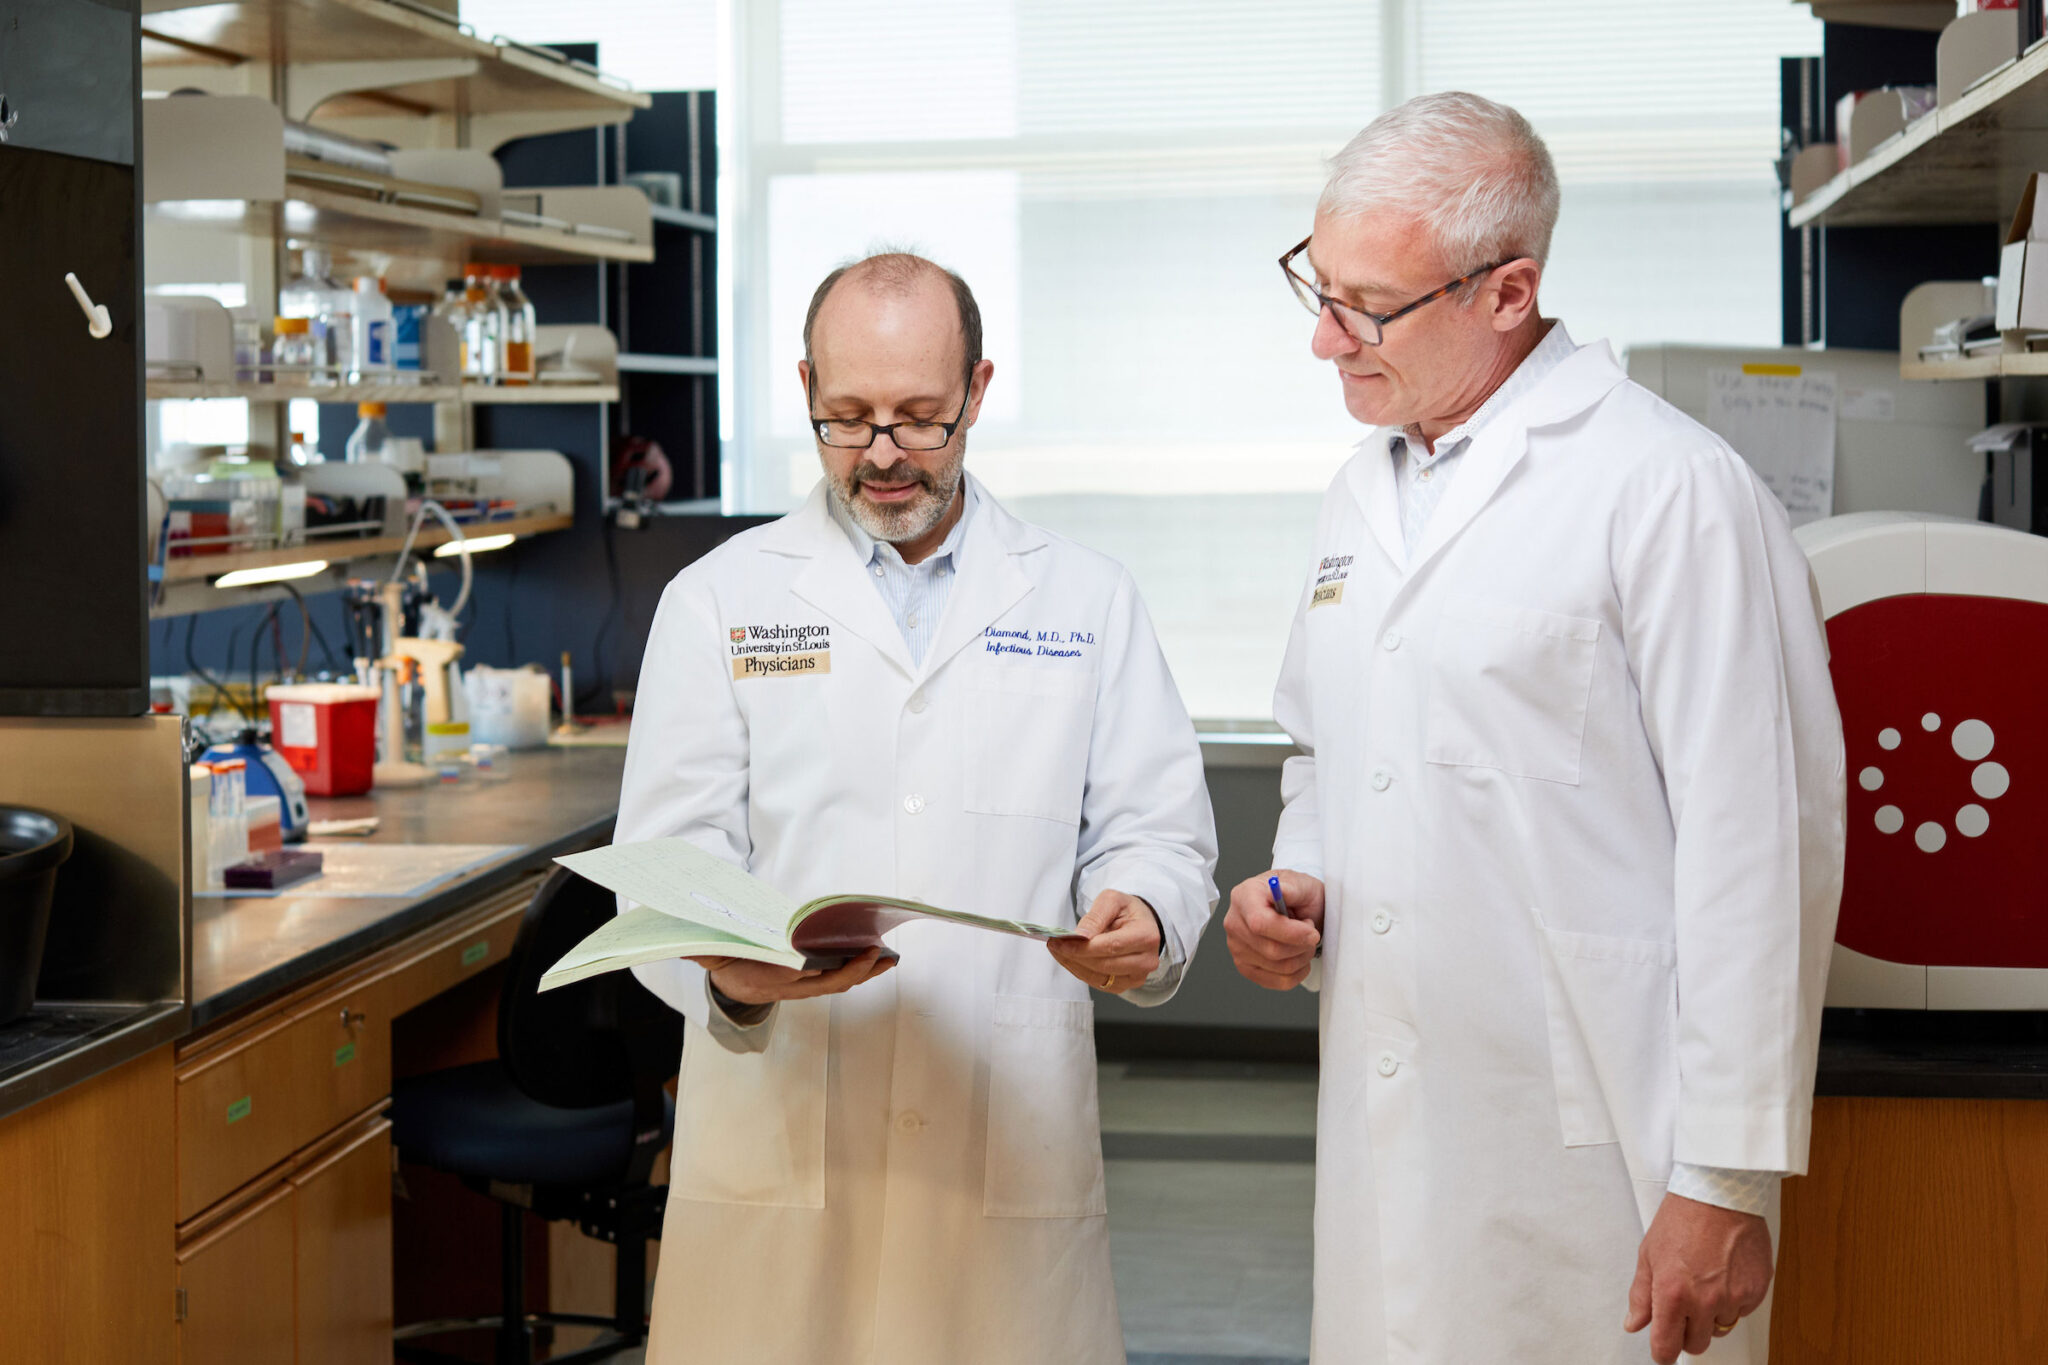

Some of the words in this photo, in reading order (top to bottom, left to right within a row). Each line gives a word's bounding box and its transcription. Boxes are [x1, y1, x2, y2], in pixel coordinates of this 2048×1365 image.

[748, 624, 830, 642] Washington
[985, 627, 1031, 641] Diamond,
[1070, 631, 1096, 645] Ph.D.
[731, 642, 780, 655] University
[782, 642, 791, 652] in
[986, 641, 1032, 655] Infectious
[1037, 645, 1082, 657] Diseases
[744, 656, 815, 675] Physicians
